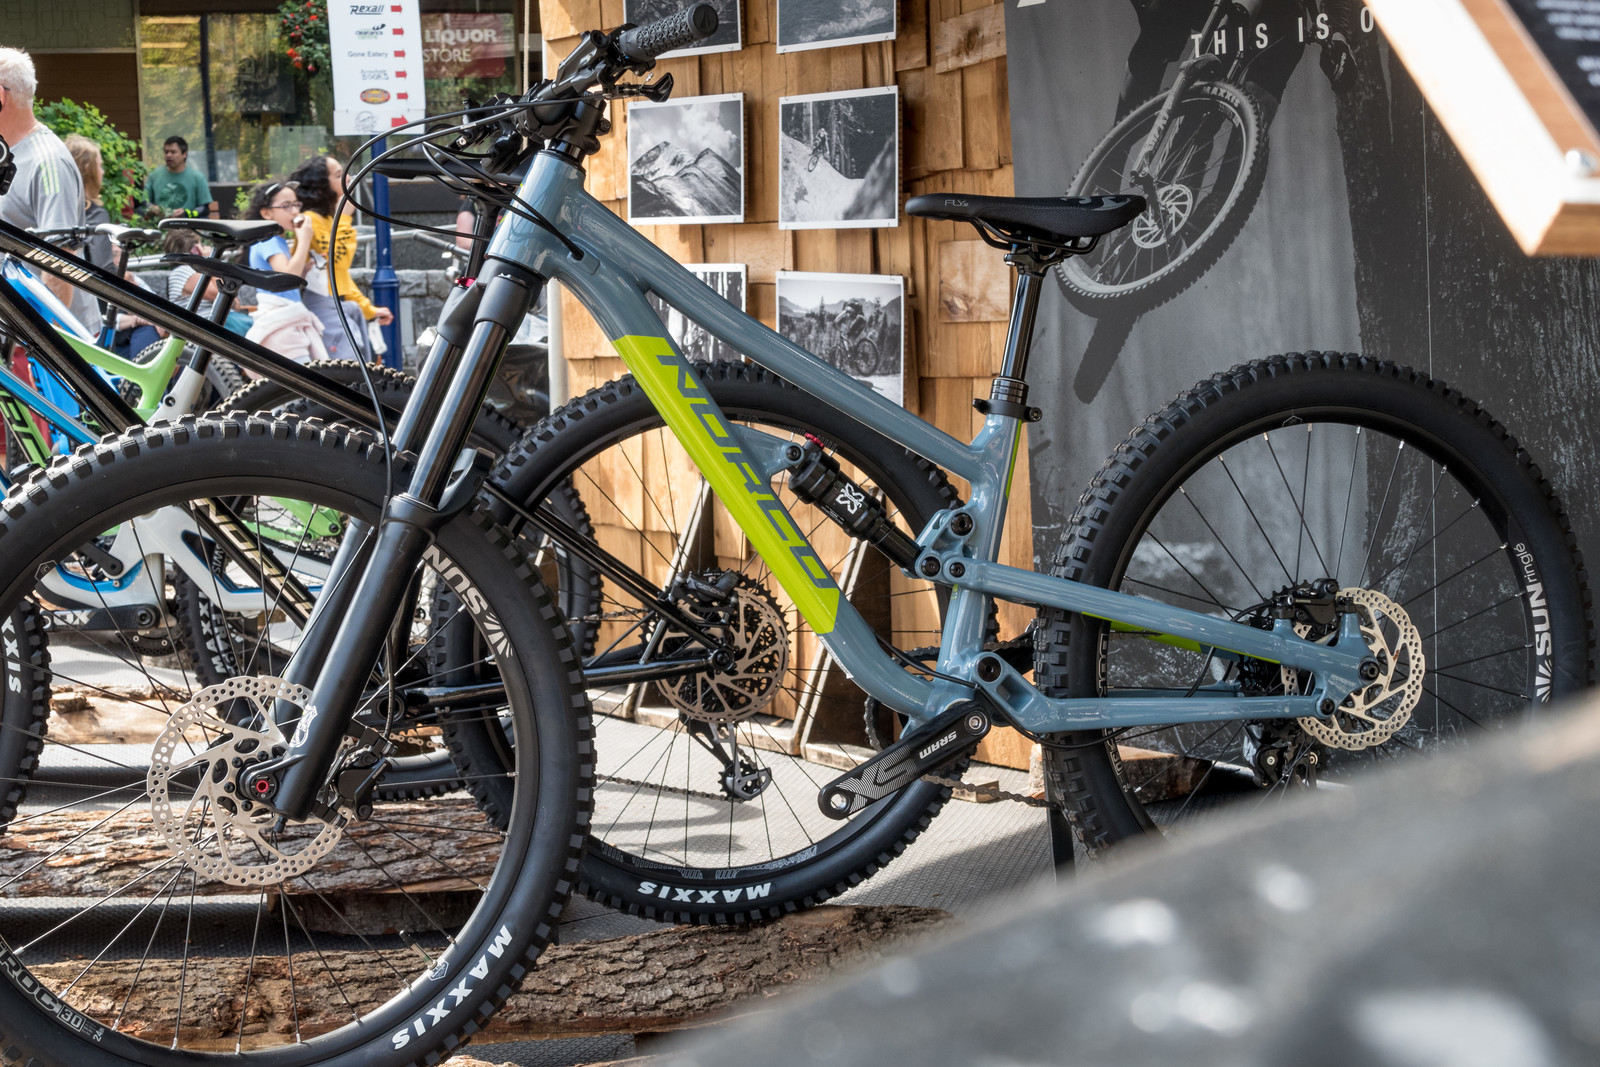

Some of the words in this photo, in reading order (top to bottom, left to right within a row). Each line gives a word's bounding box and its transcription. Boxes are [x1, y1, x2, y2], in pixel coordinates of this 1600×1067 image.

[350, 5, 385, 15] Rexall
[423, 48, 472, 63] STORE
[424, 28, 498, 45] LIQUOR
[1190, 23, 1269, 59] THIS
[1297, 13, 1330, 42] IS
[1201, 86, 1240, 108] MAXXIS
[655, 354, 840, 590] NORCO
[422, 544, 488, 615] SUN
[1514, 542, 1537, 583] ringlé
[1525, 582, 1552, 656] SUN
[918, 730, 957, 760] SRAM
[637, 881, 772, 904] MAXXIS
[0, 942, 62, 1014] ROC
[391, 924, 513, 1050] MAXXIS
